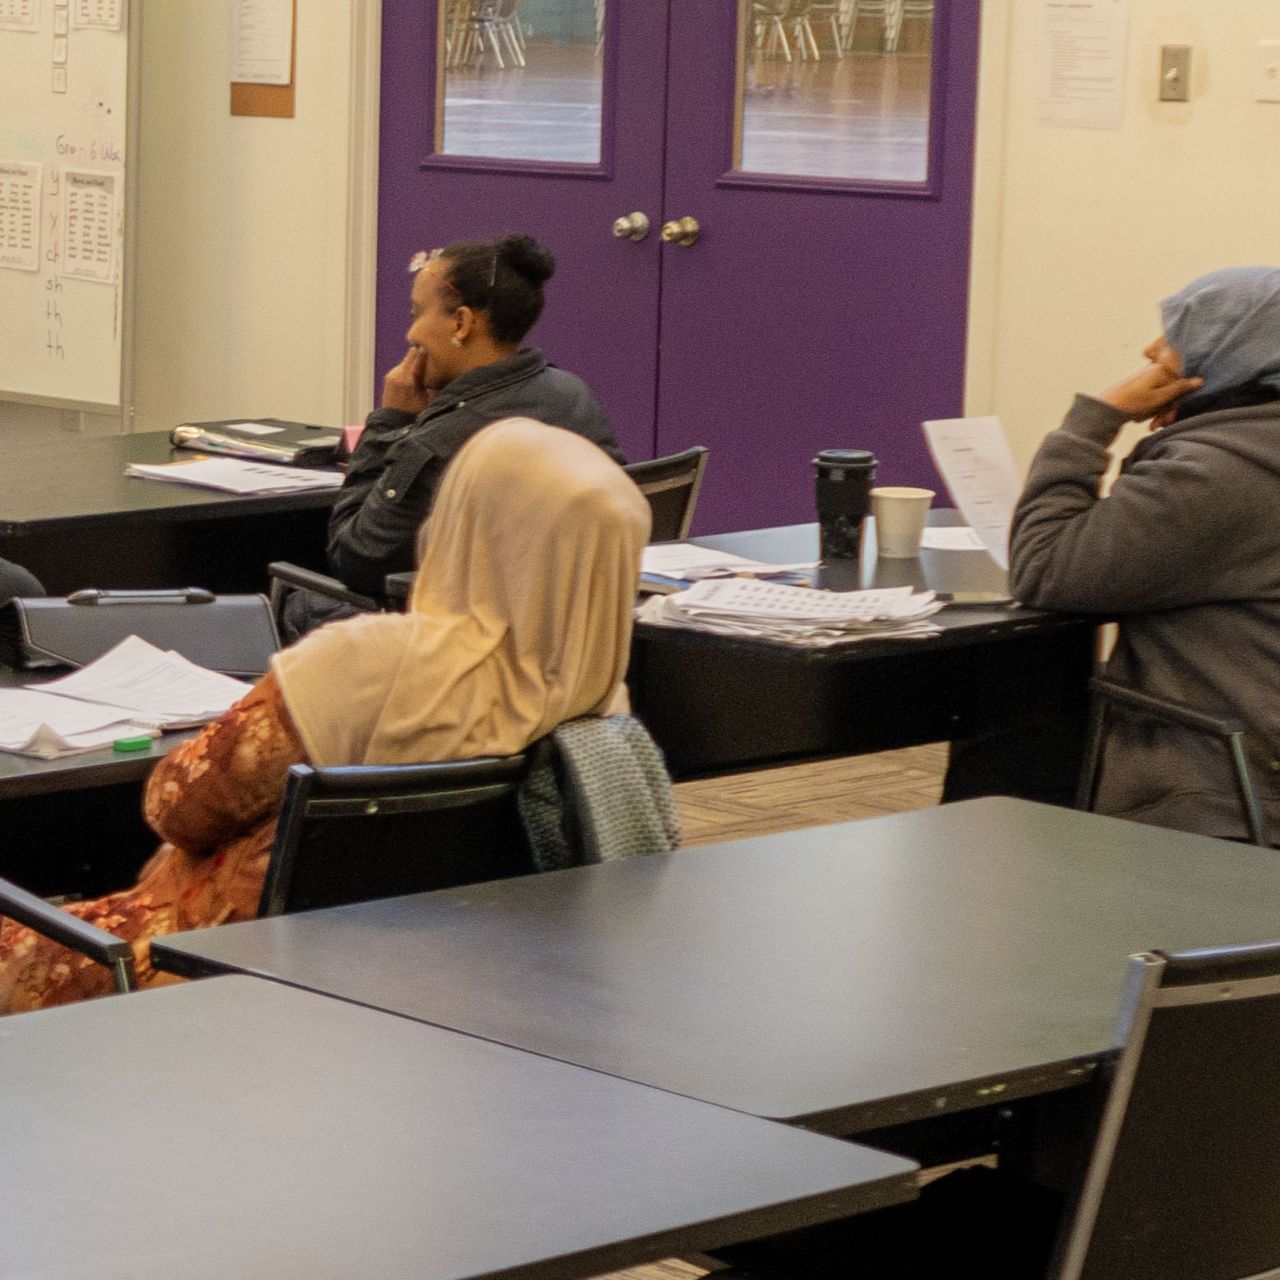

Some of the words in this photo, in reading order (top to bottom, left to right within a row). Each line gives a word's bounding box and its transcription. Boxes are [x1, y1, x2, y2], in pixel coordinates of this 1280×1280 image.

[45, 276, 64, 293] sh
[46, 300, 63, 327] th
[46, 329, 65, 360] th
